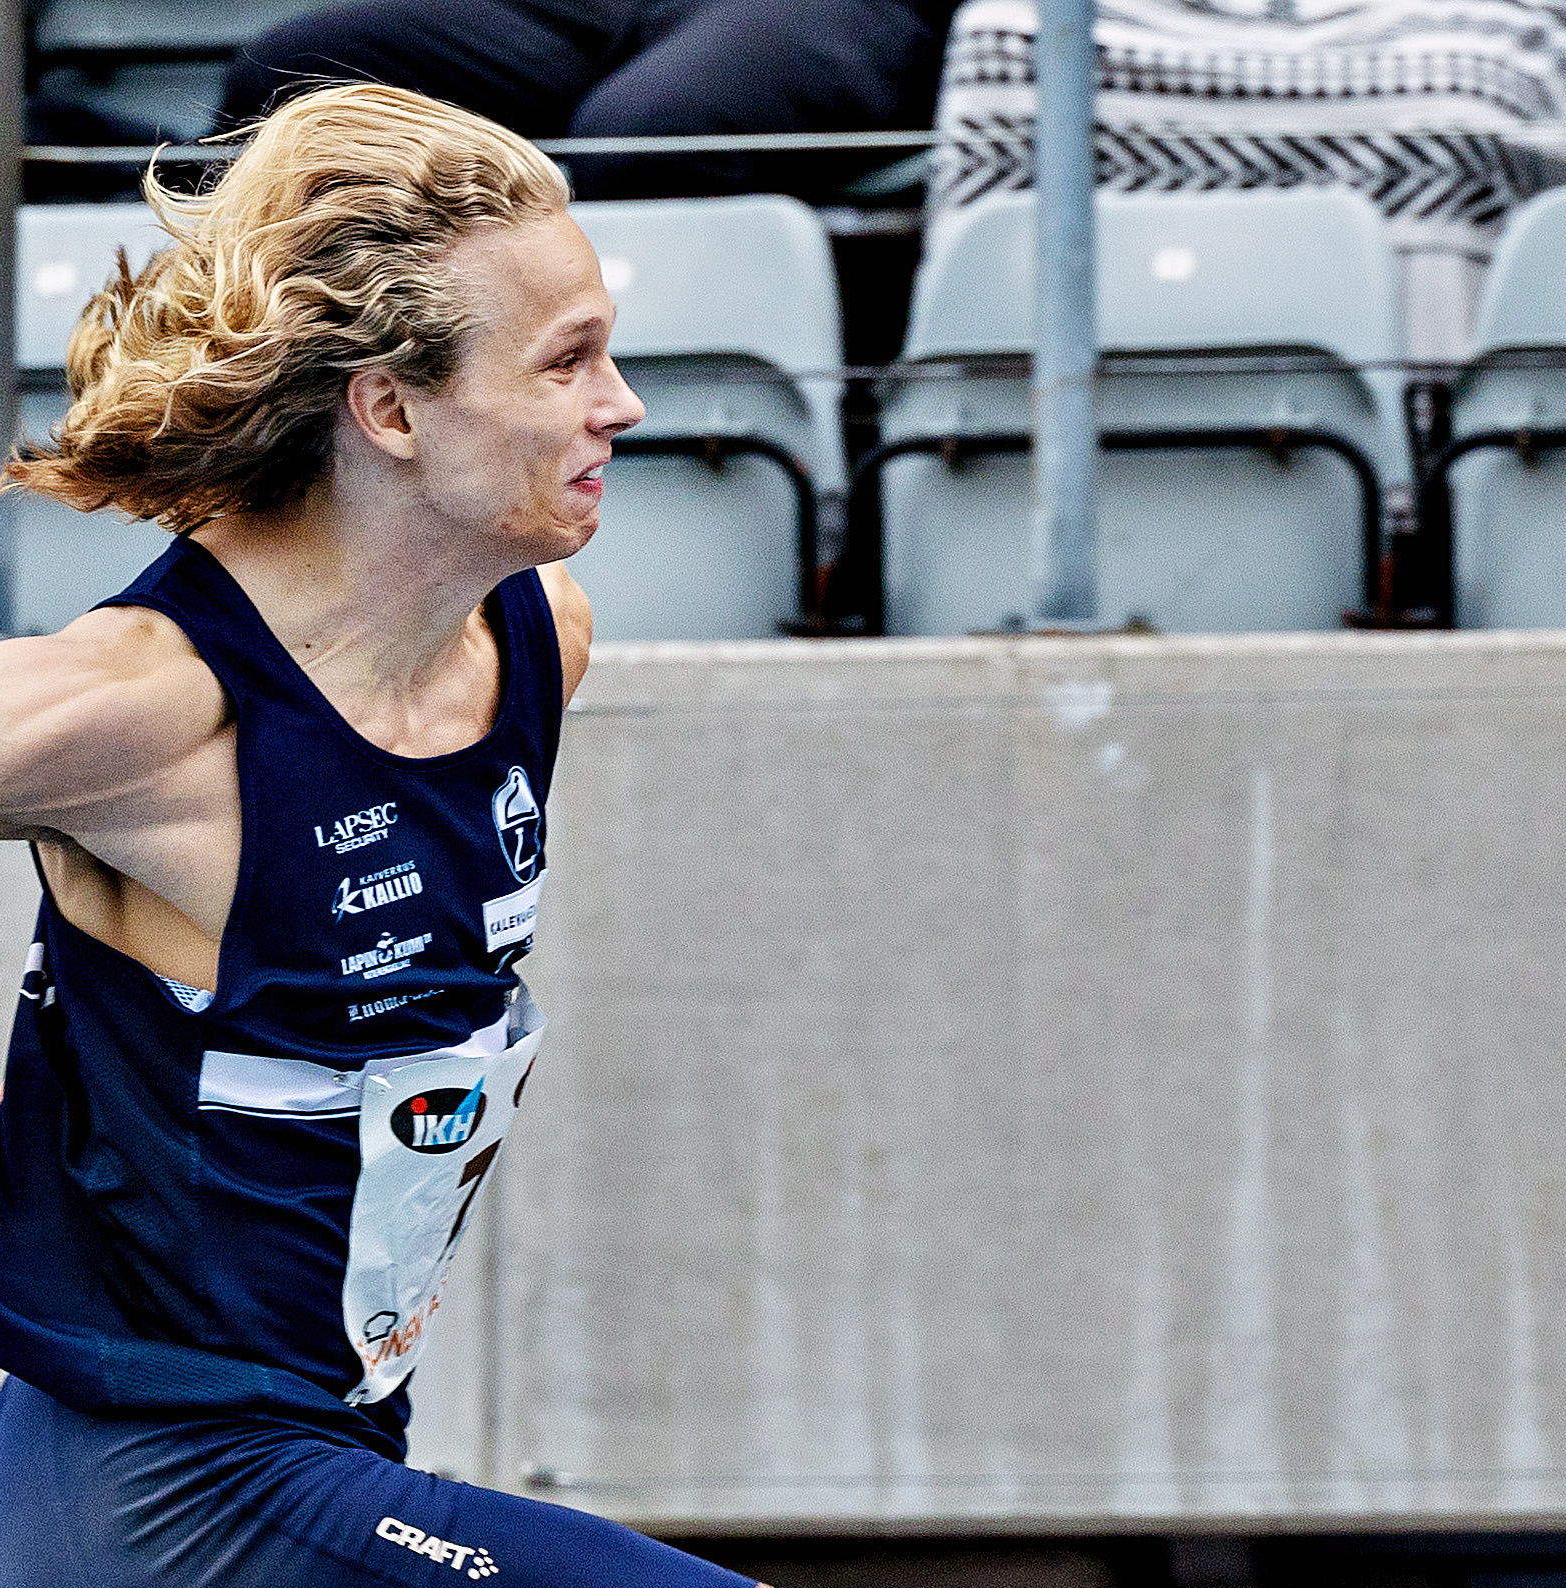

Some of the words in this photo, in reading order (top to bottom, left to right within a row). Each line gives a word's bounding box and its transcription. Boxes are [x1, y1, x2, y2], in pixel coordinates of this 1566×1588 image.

[314, 802, 398, 847] LAPSEC
[335, 828, 388, 854] SECURITY
[362, 872, 423, 909] KALLIO
[375, 1516, 476, 1571] CRAFT
